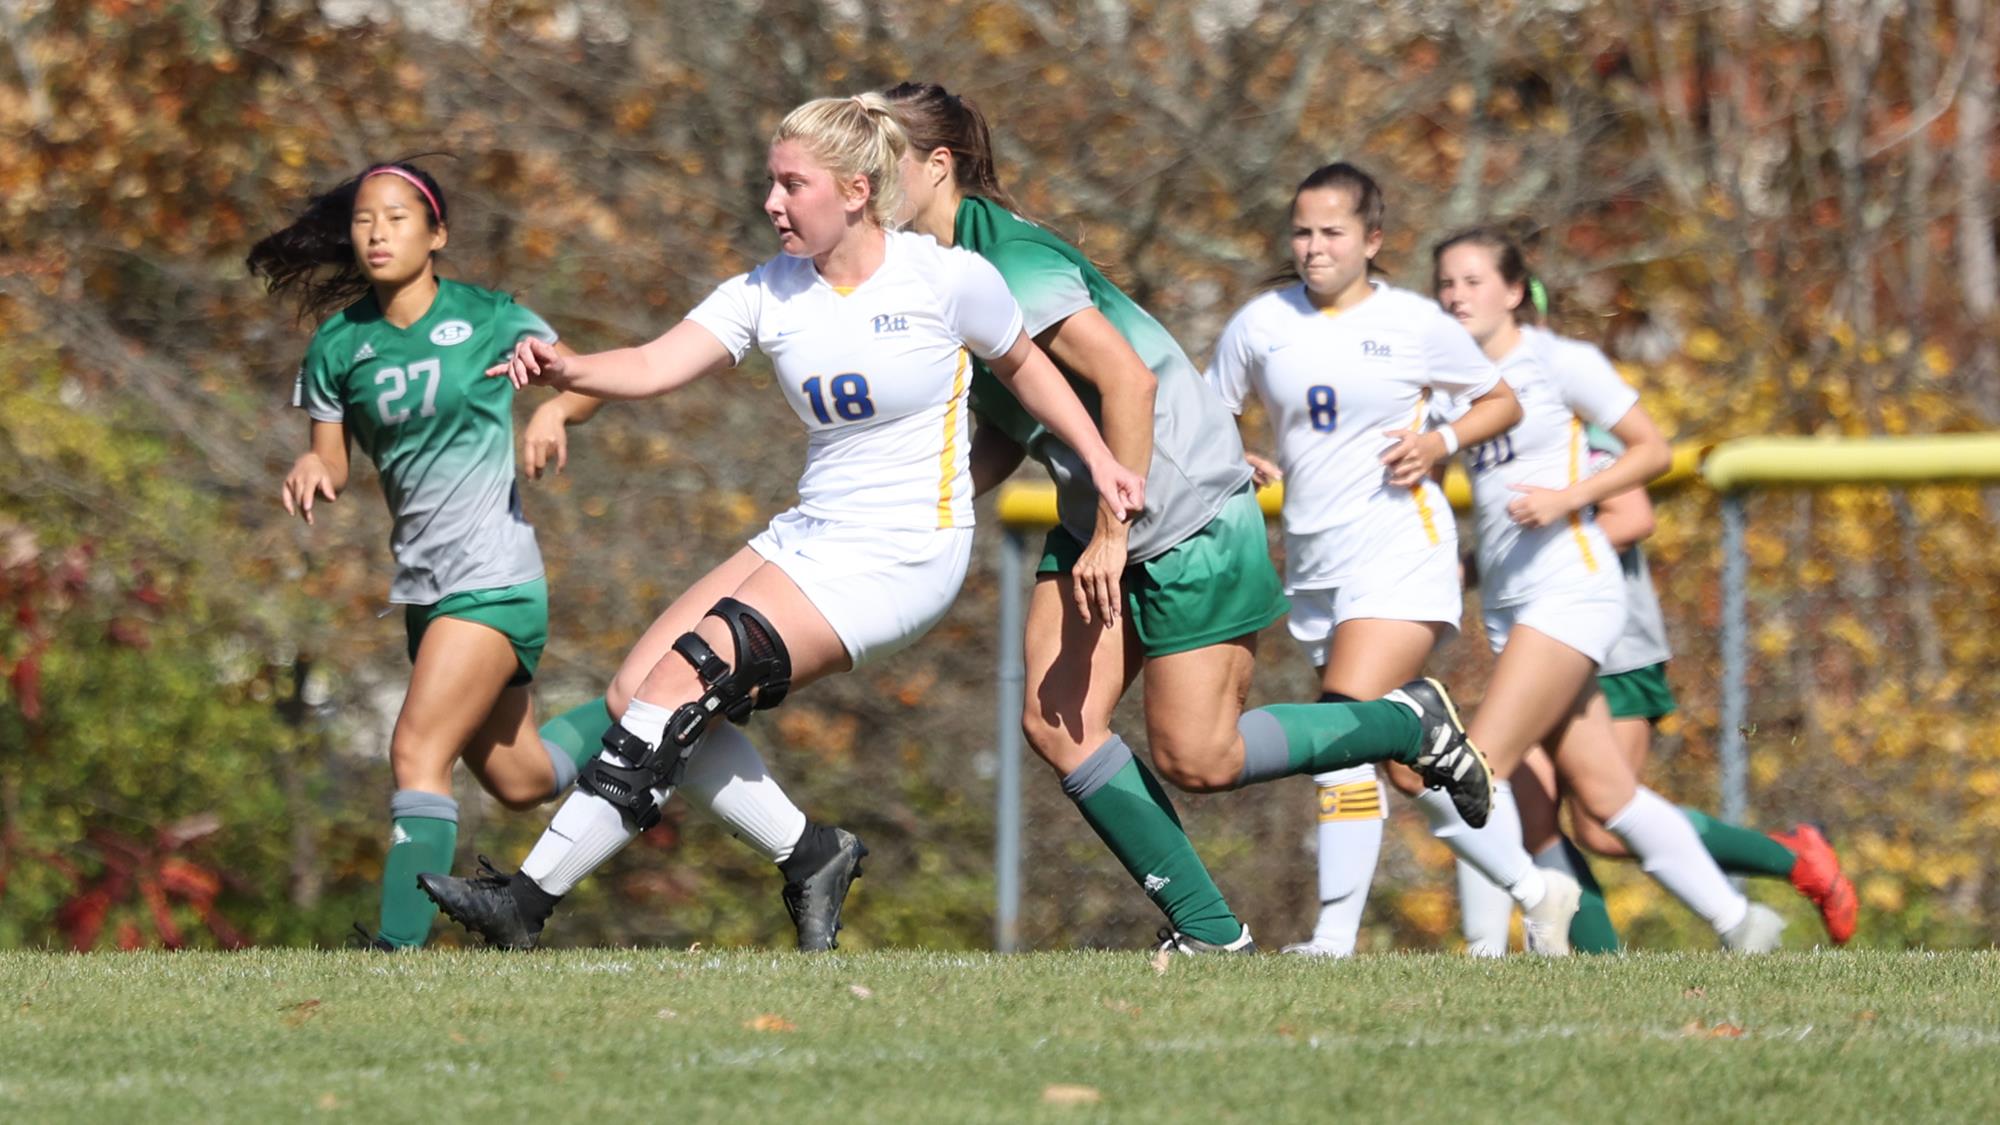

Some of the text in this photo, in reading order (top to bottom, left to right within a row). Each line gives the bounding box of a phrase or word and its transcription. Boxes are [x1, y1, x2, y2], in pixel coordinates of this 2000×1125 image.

[870, 314, 909, 334] Pitt
[1360, 340, 1393, 357] Pitt
[375, 358, 441, 426] 27
[802, 372, 876, 425] 18
[1307, 385, 1338, 433] 8
